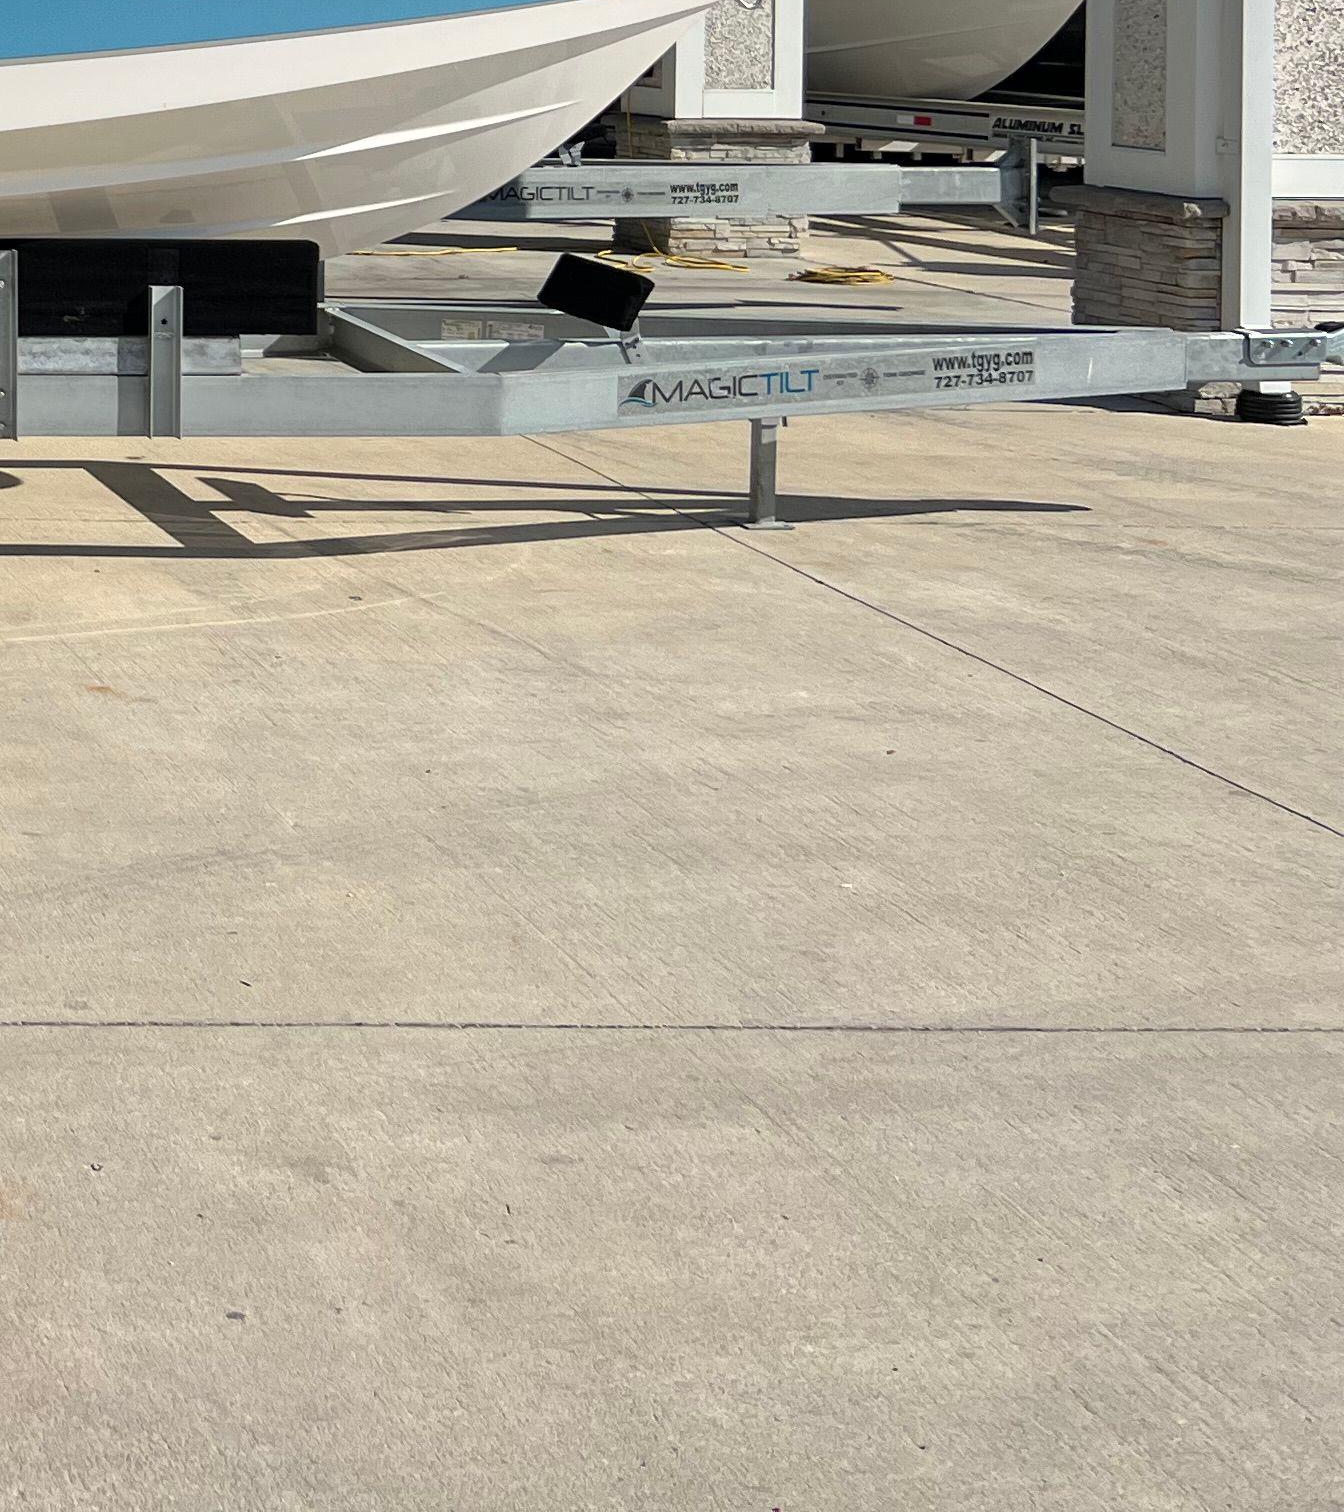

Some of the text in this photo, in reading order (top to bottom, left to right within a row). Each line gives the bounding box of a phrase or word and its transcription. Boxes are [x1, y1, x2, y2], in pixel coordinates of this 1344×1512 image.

[992, 117, 1064, 134] ALUMINUM
[670, 182, 739, 196] www.tgyg.com
[671, 194, 739, 205] 727-734-8707
[932, 350, 1034, 372] www.tgyg.com
[652, 369, 820, 404] MAGICTILT
[933, 369, 1035, 389] 727-734-8707
